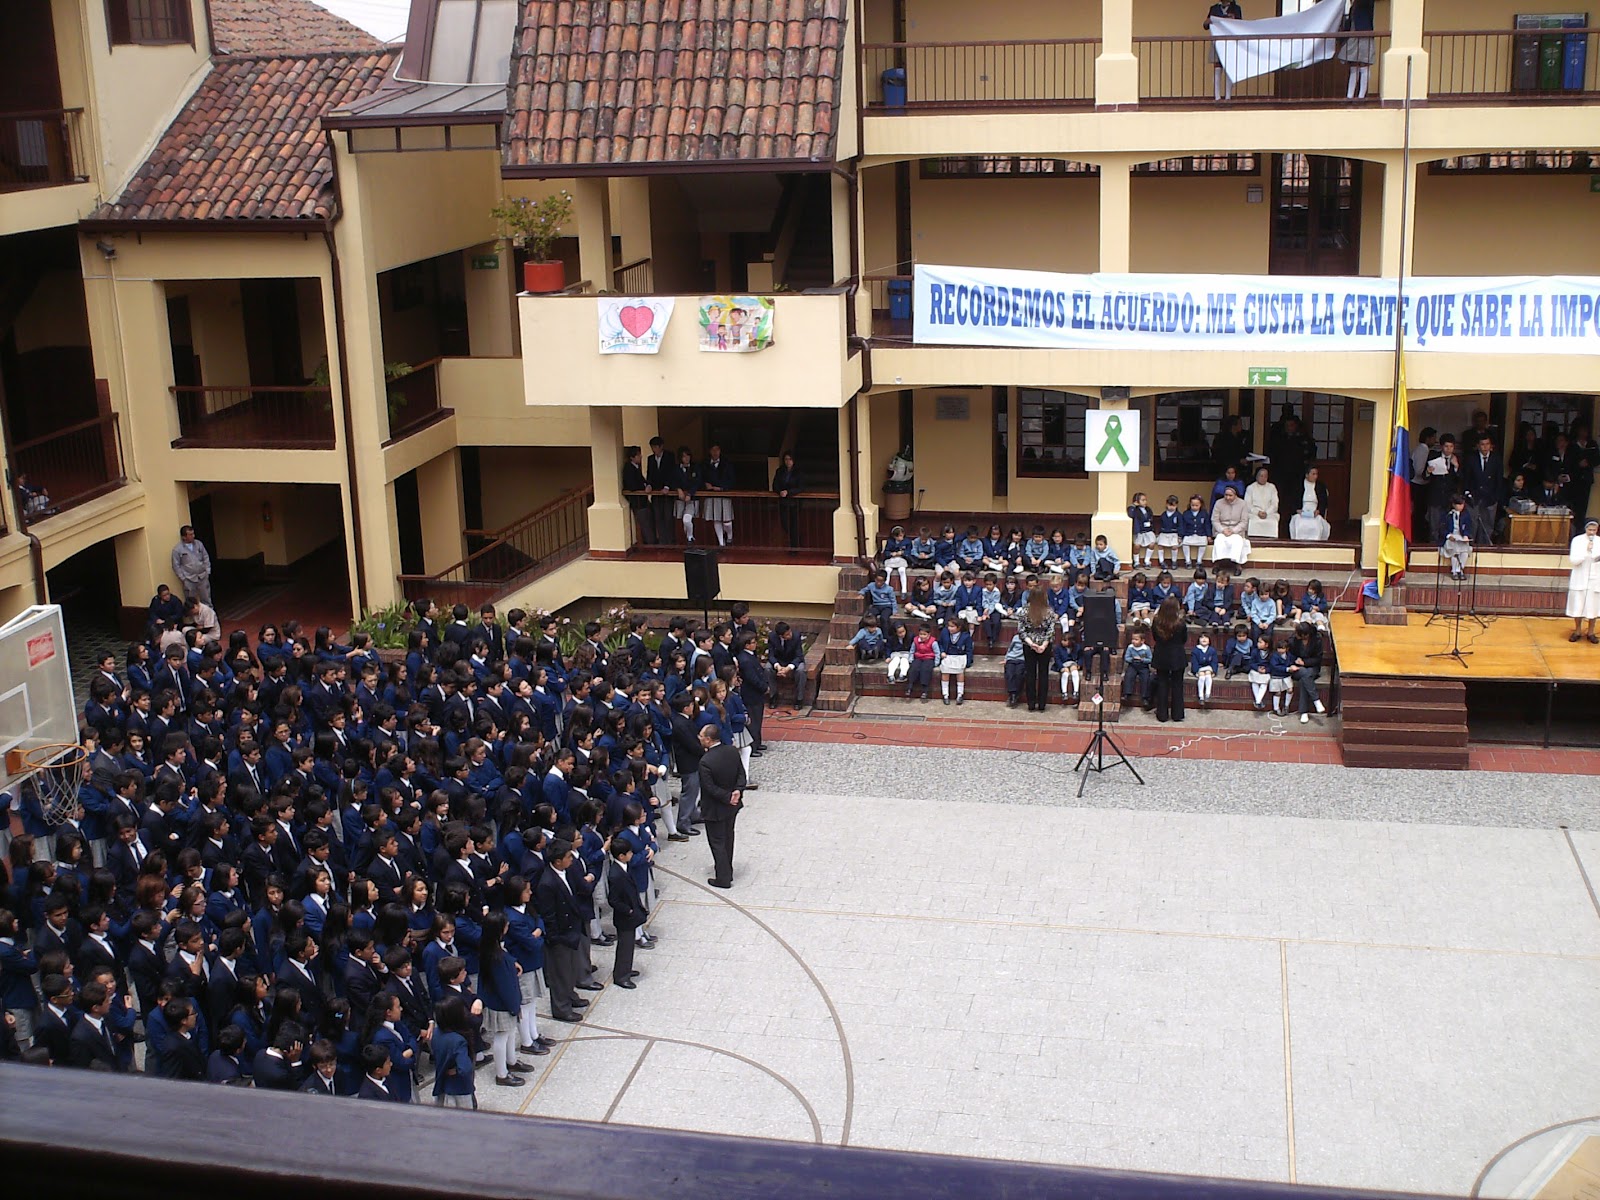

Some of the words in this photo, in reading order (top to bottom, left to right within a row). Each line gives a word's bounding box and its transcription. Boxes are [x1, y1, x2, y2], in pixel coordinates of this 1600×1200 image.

[929, 283, 1065, 329] RECORDEMOS
[1071, 290, 1095, 330] EL
[1100, 291, 1201, 334] ACUERDO:
[1205, 293, 1237, 334] ME
[1243, 293, 1305, 335] GUSTA
[1310, 293, 1335, 335] LA
[1341, 293, 1410, 337] GENTE
[1415, 294, 1456, 347] QUE
[1460, 294, 1513, 337] SABE
[1519, 294, 1544, 337] LA
